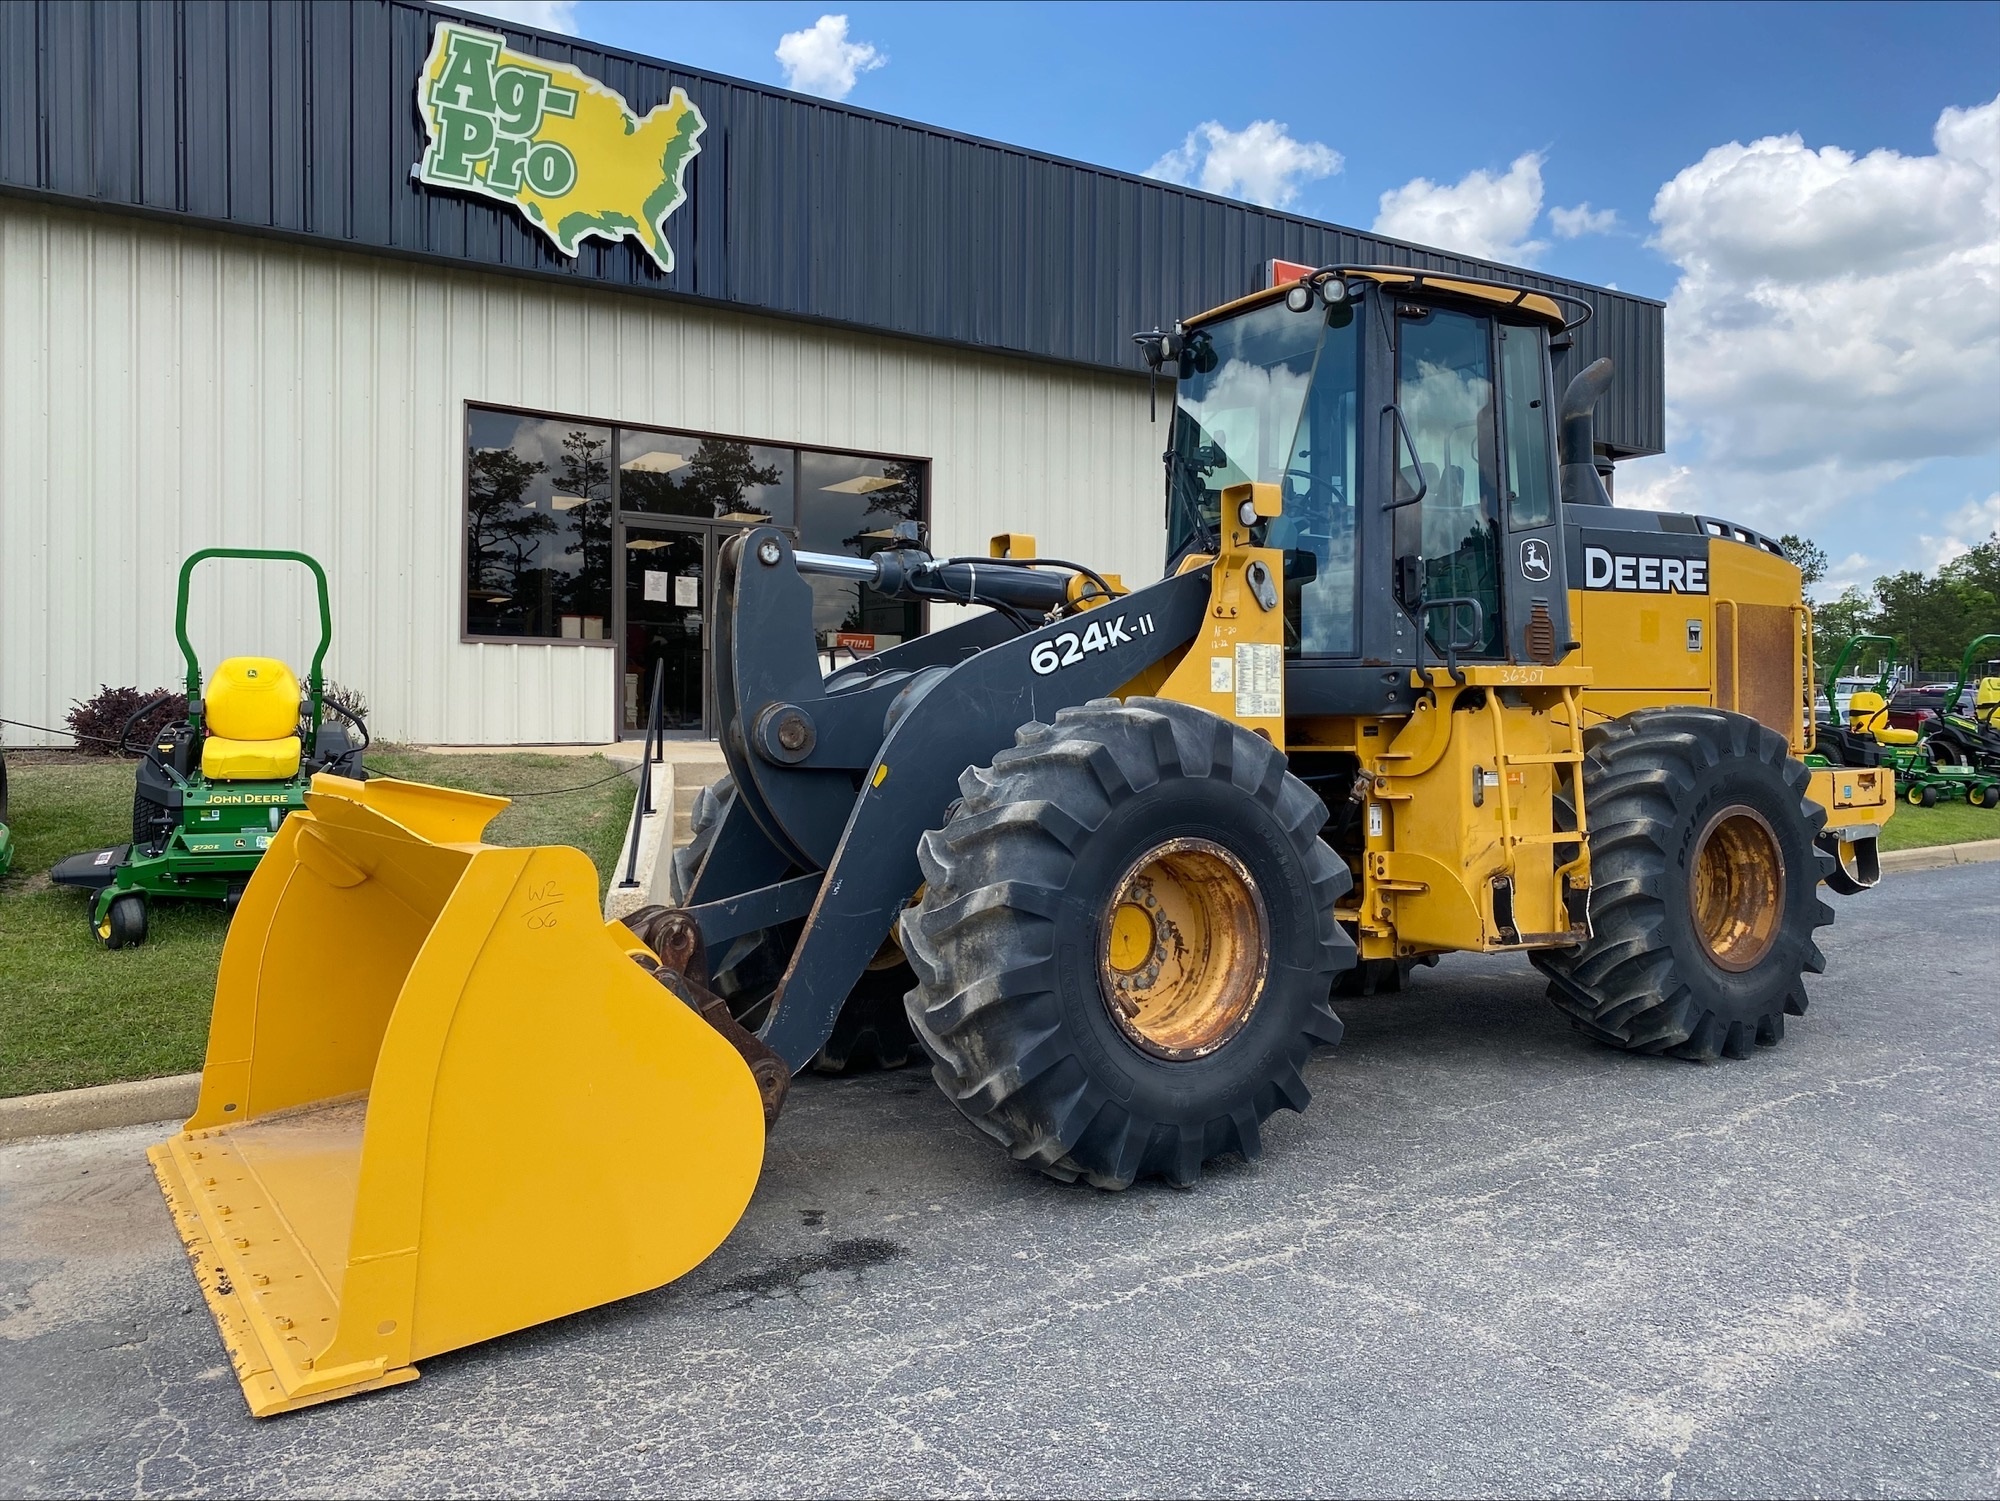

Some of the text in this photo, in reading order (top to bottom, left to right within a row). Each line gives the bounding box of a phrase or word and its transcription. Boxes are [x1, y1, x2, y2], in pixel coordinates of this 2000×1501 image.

[429, 32, 578, 136] Ag-
[428, 106, 577, 197] Pro
[1585, 547, 1707, 592] DEERE
[843, 639, 872, 648] STIHL
[1501, 669, 1544, 684] 36307
[206, 794, 288, 804] JOHN DEERE
